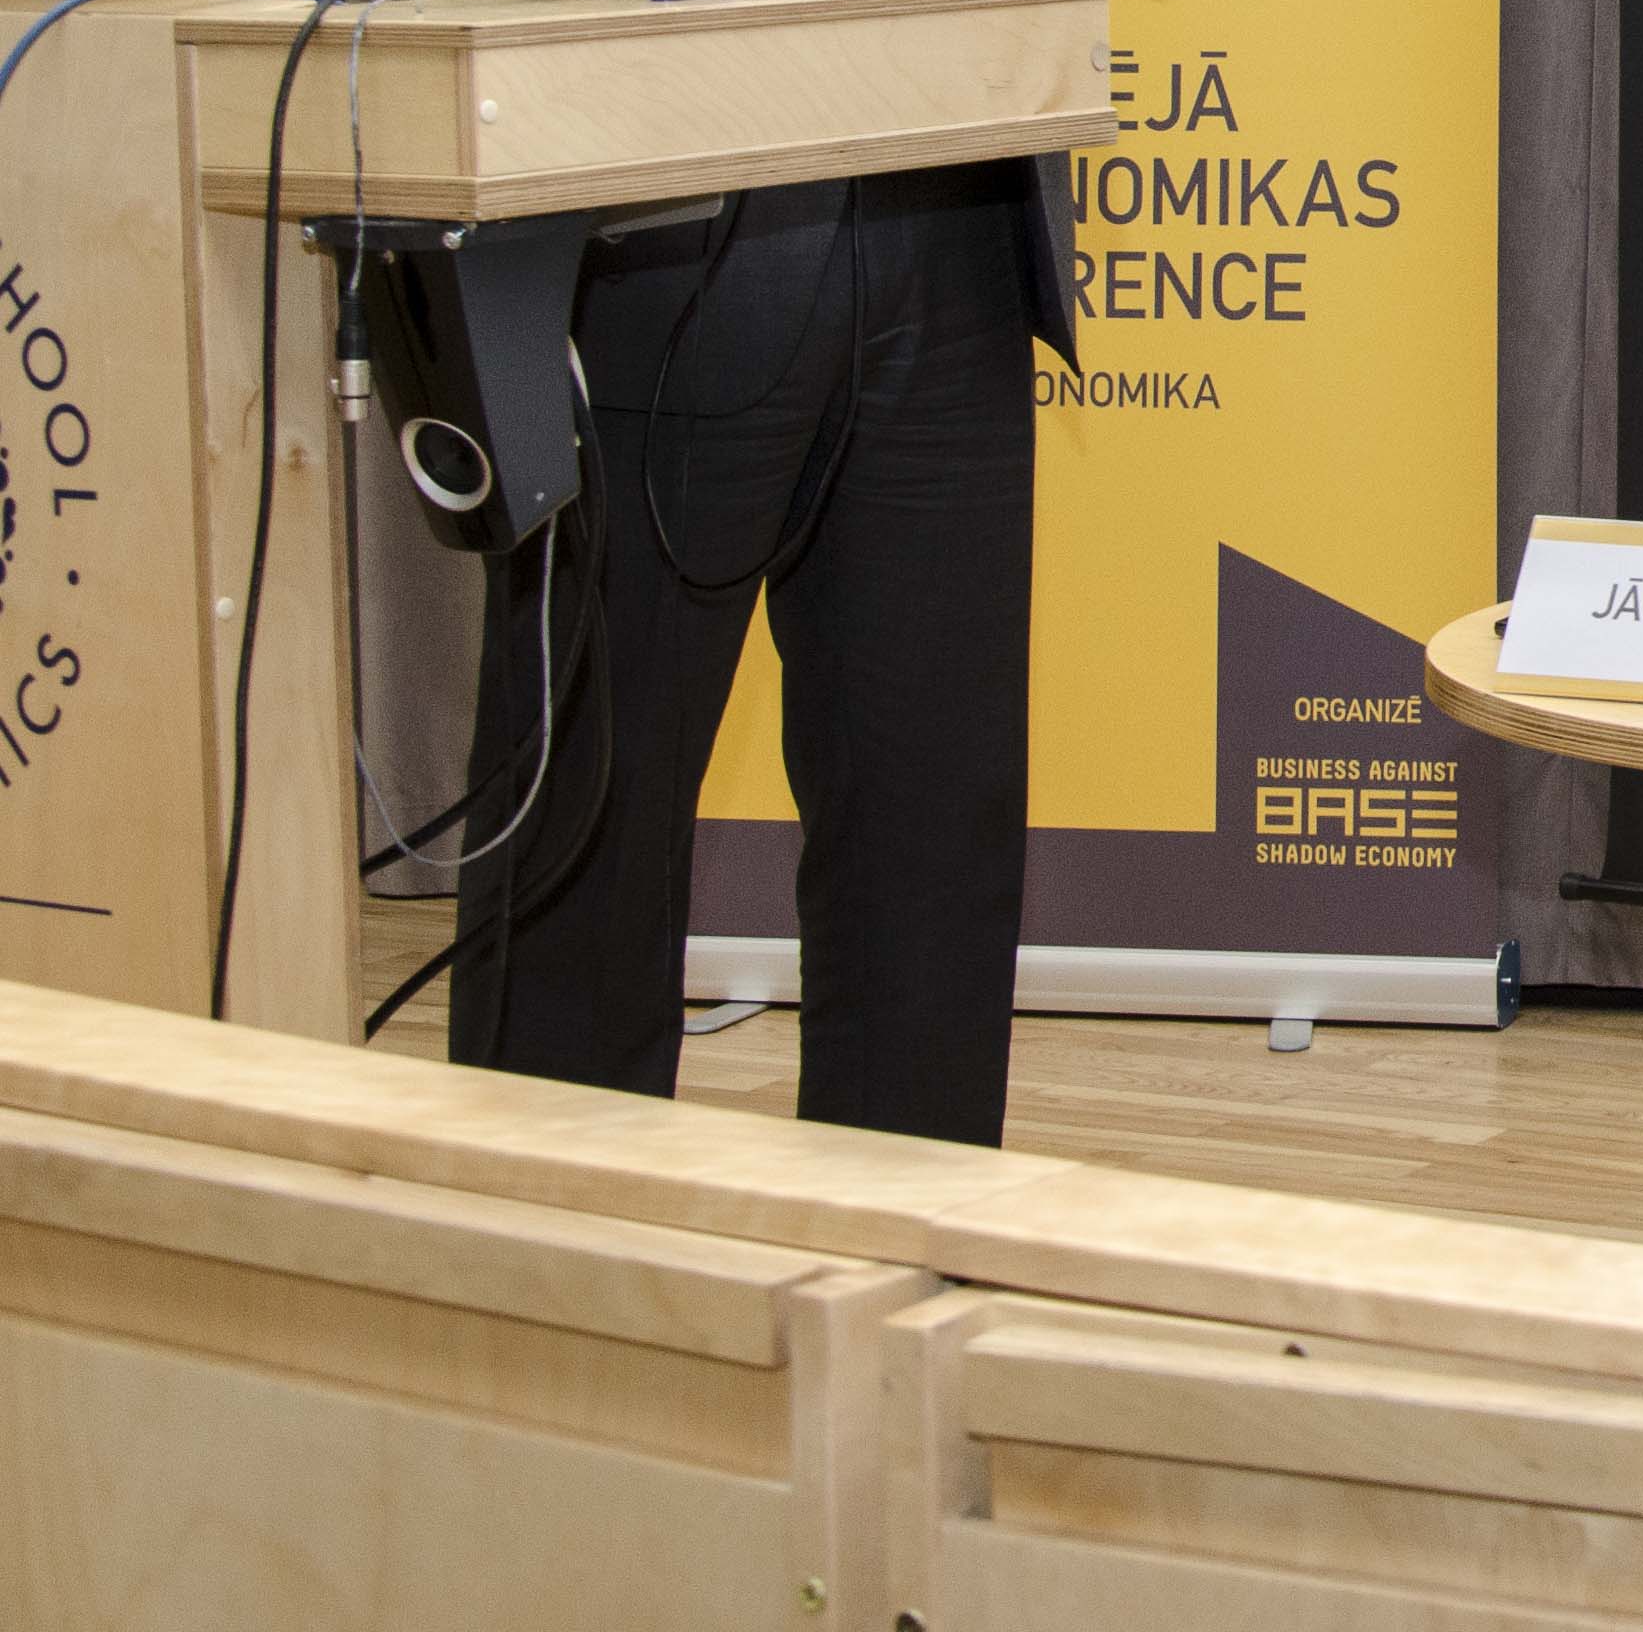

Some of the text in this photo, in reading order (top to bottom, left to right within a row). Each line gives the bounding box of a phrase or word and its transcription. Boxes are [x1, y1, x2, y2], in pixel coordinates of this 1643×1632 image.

[0, 238, 98, 517] HOOL
[1033, 370, 1221, 410] ONOMIKA
[1294, 696, 1422, 724] ORGANIZĒ
[1256, 758, 1458, 782] BUSINESS AGAINST
[1256, 786, 1458, 839] BASE
[1256, 843, 1457, 868] SHADOW ECONOMY
